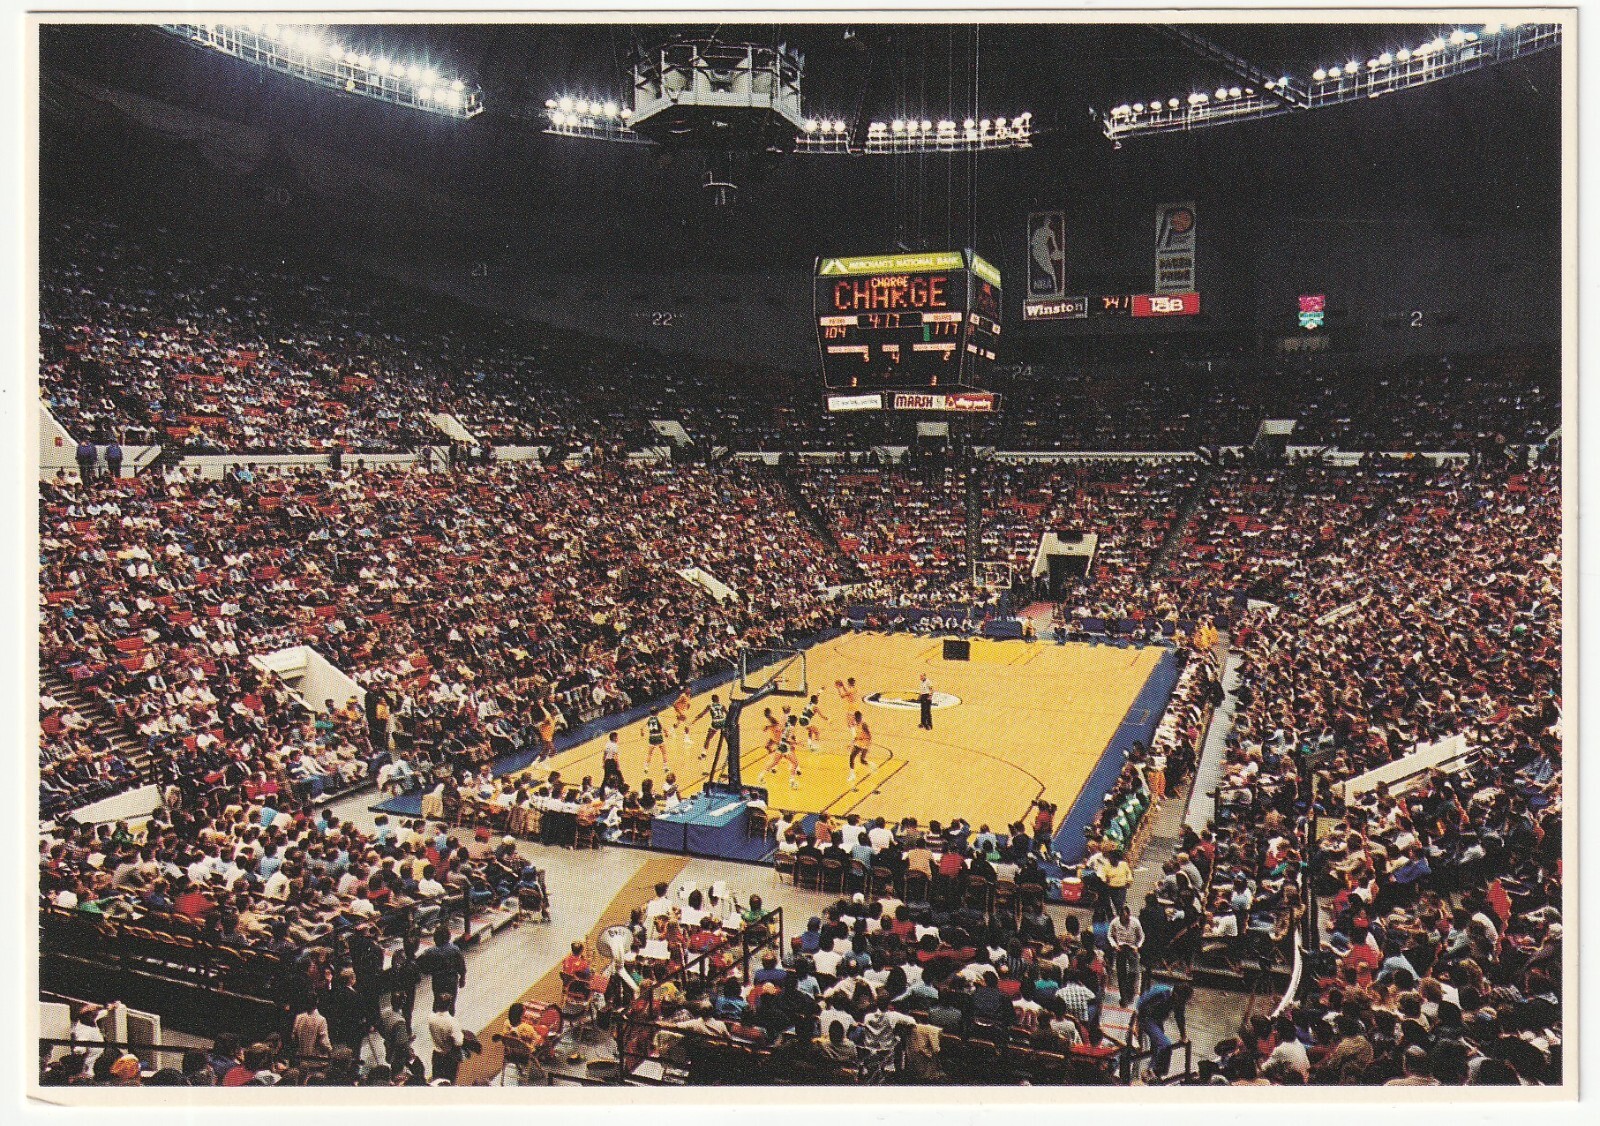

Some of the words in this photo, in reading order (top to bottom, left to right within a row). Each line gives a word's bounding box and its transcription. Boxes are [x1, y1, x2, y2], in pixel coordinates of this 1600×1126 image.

[470, 262, 488, 277] 21
[849, 260, 894, 269] MERCHANTS
[896, 258, 932, 267] NATIONAL
[937, 256, 959, 265] BANK
[871, 276, 910, 288] CHARGE
[834, 277, 948, 310] CHARGE
[1027, 302, 1084, 316] Winston
[652, 311, 673, 326] 22
[1410, 311, 1423, 327] 2
[825, 327, 847, 338] 104
[895, 395, 933, 408] MARSH
